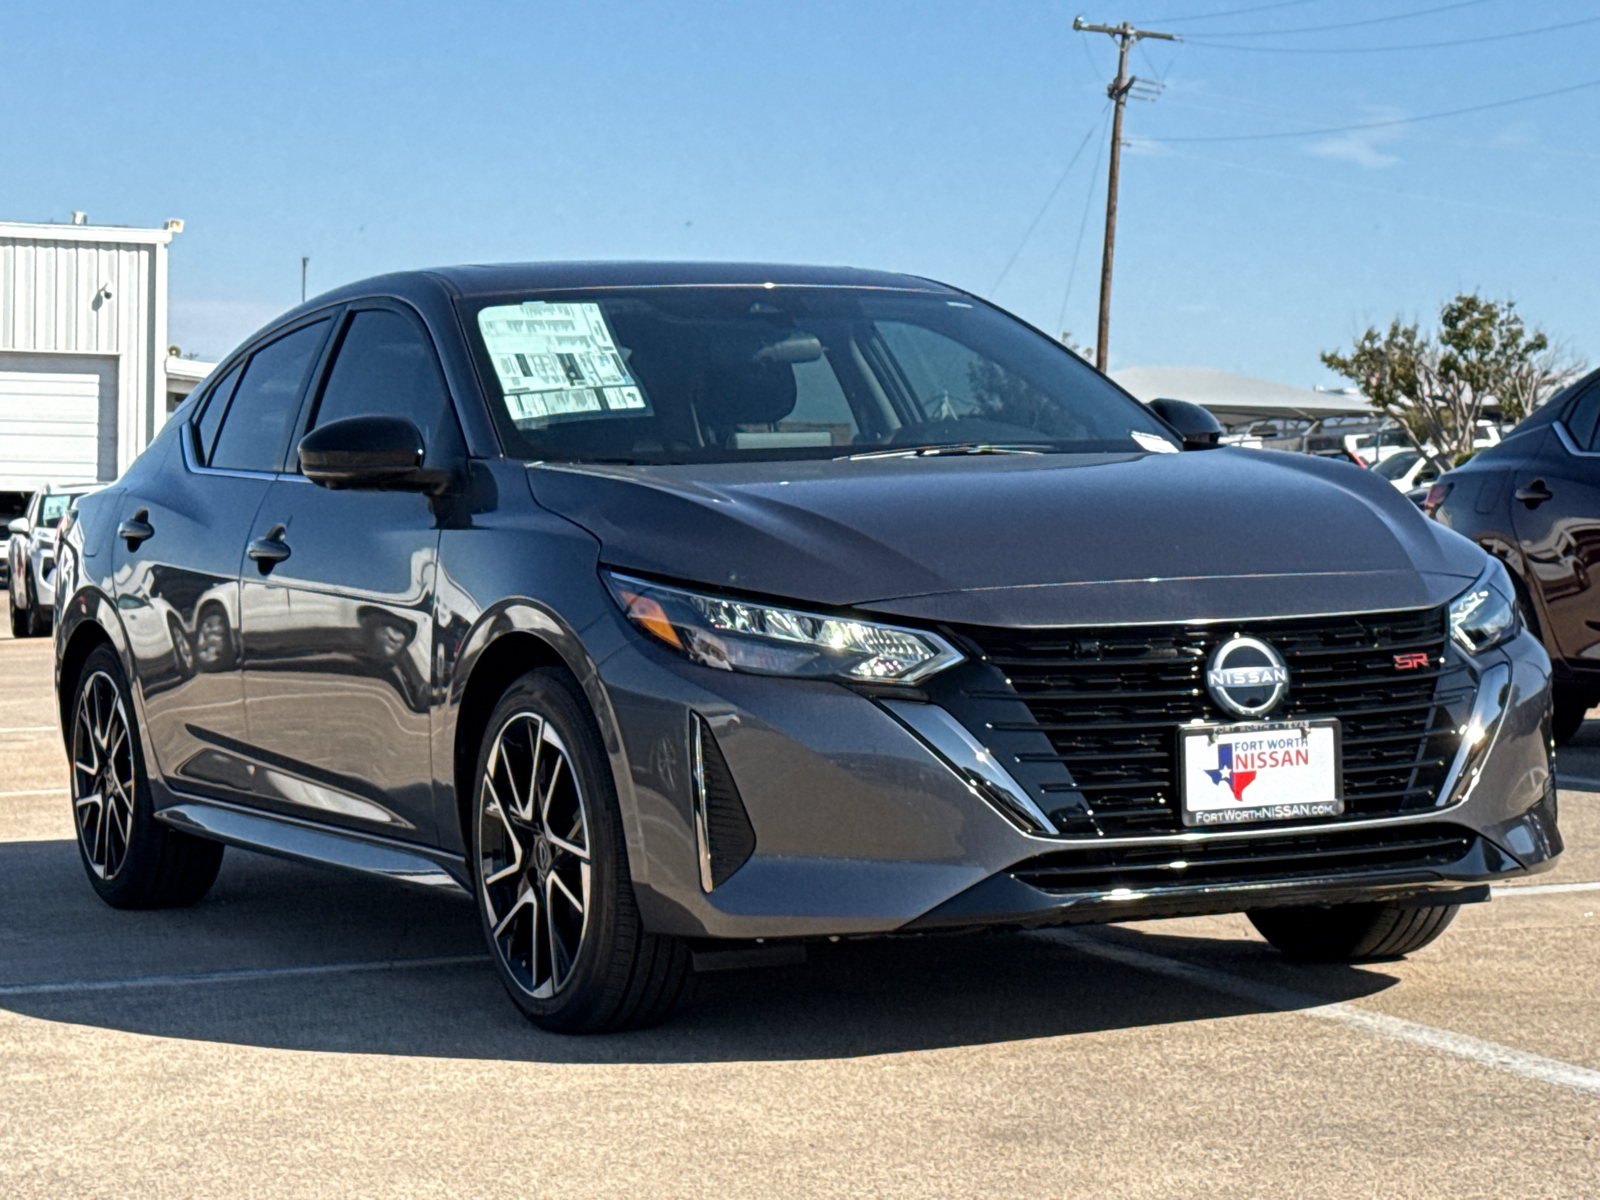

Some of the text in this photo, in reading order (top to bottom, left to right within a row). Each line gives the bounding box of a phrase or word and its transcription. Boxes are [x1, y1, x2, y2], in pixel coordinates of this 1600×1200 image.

[1393, 653, 1429, 670] SR
[1210, 669, 1286, 685] NISSAN
[1239, 723, 1269, 732] WORTH
[1283, 720, 1310, 729] TEXAS
[1234, 737, 1308, 752] FORT WORTH
[1235, 749, 1309, 770] NISSAN
